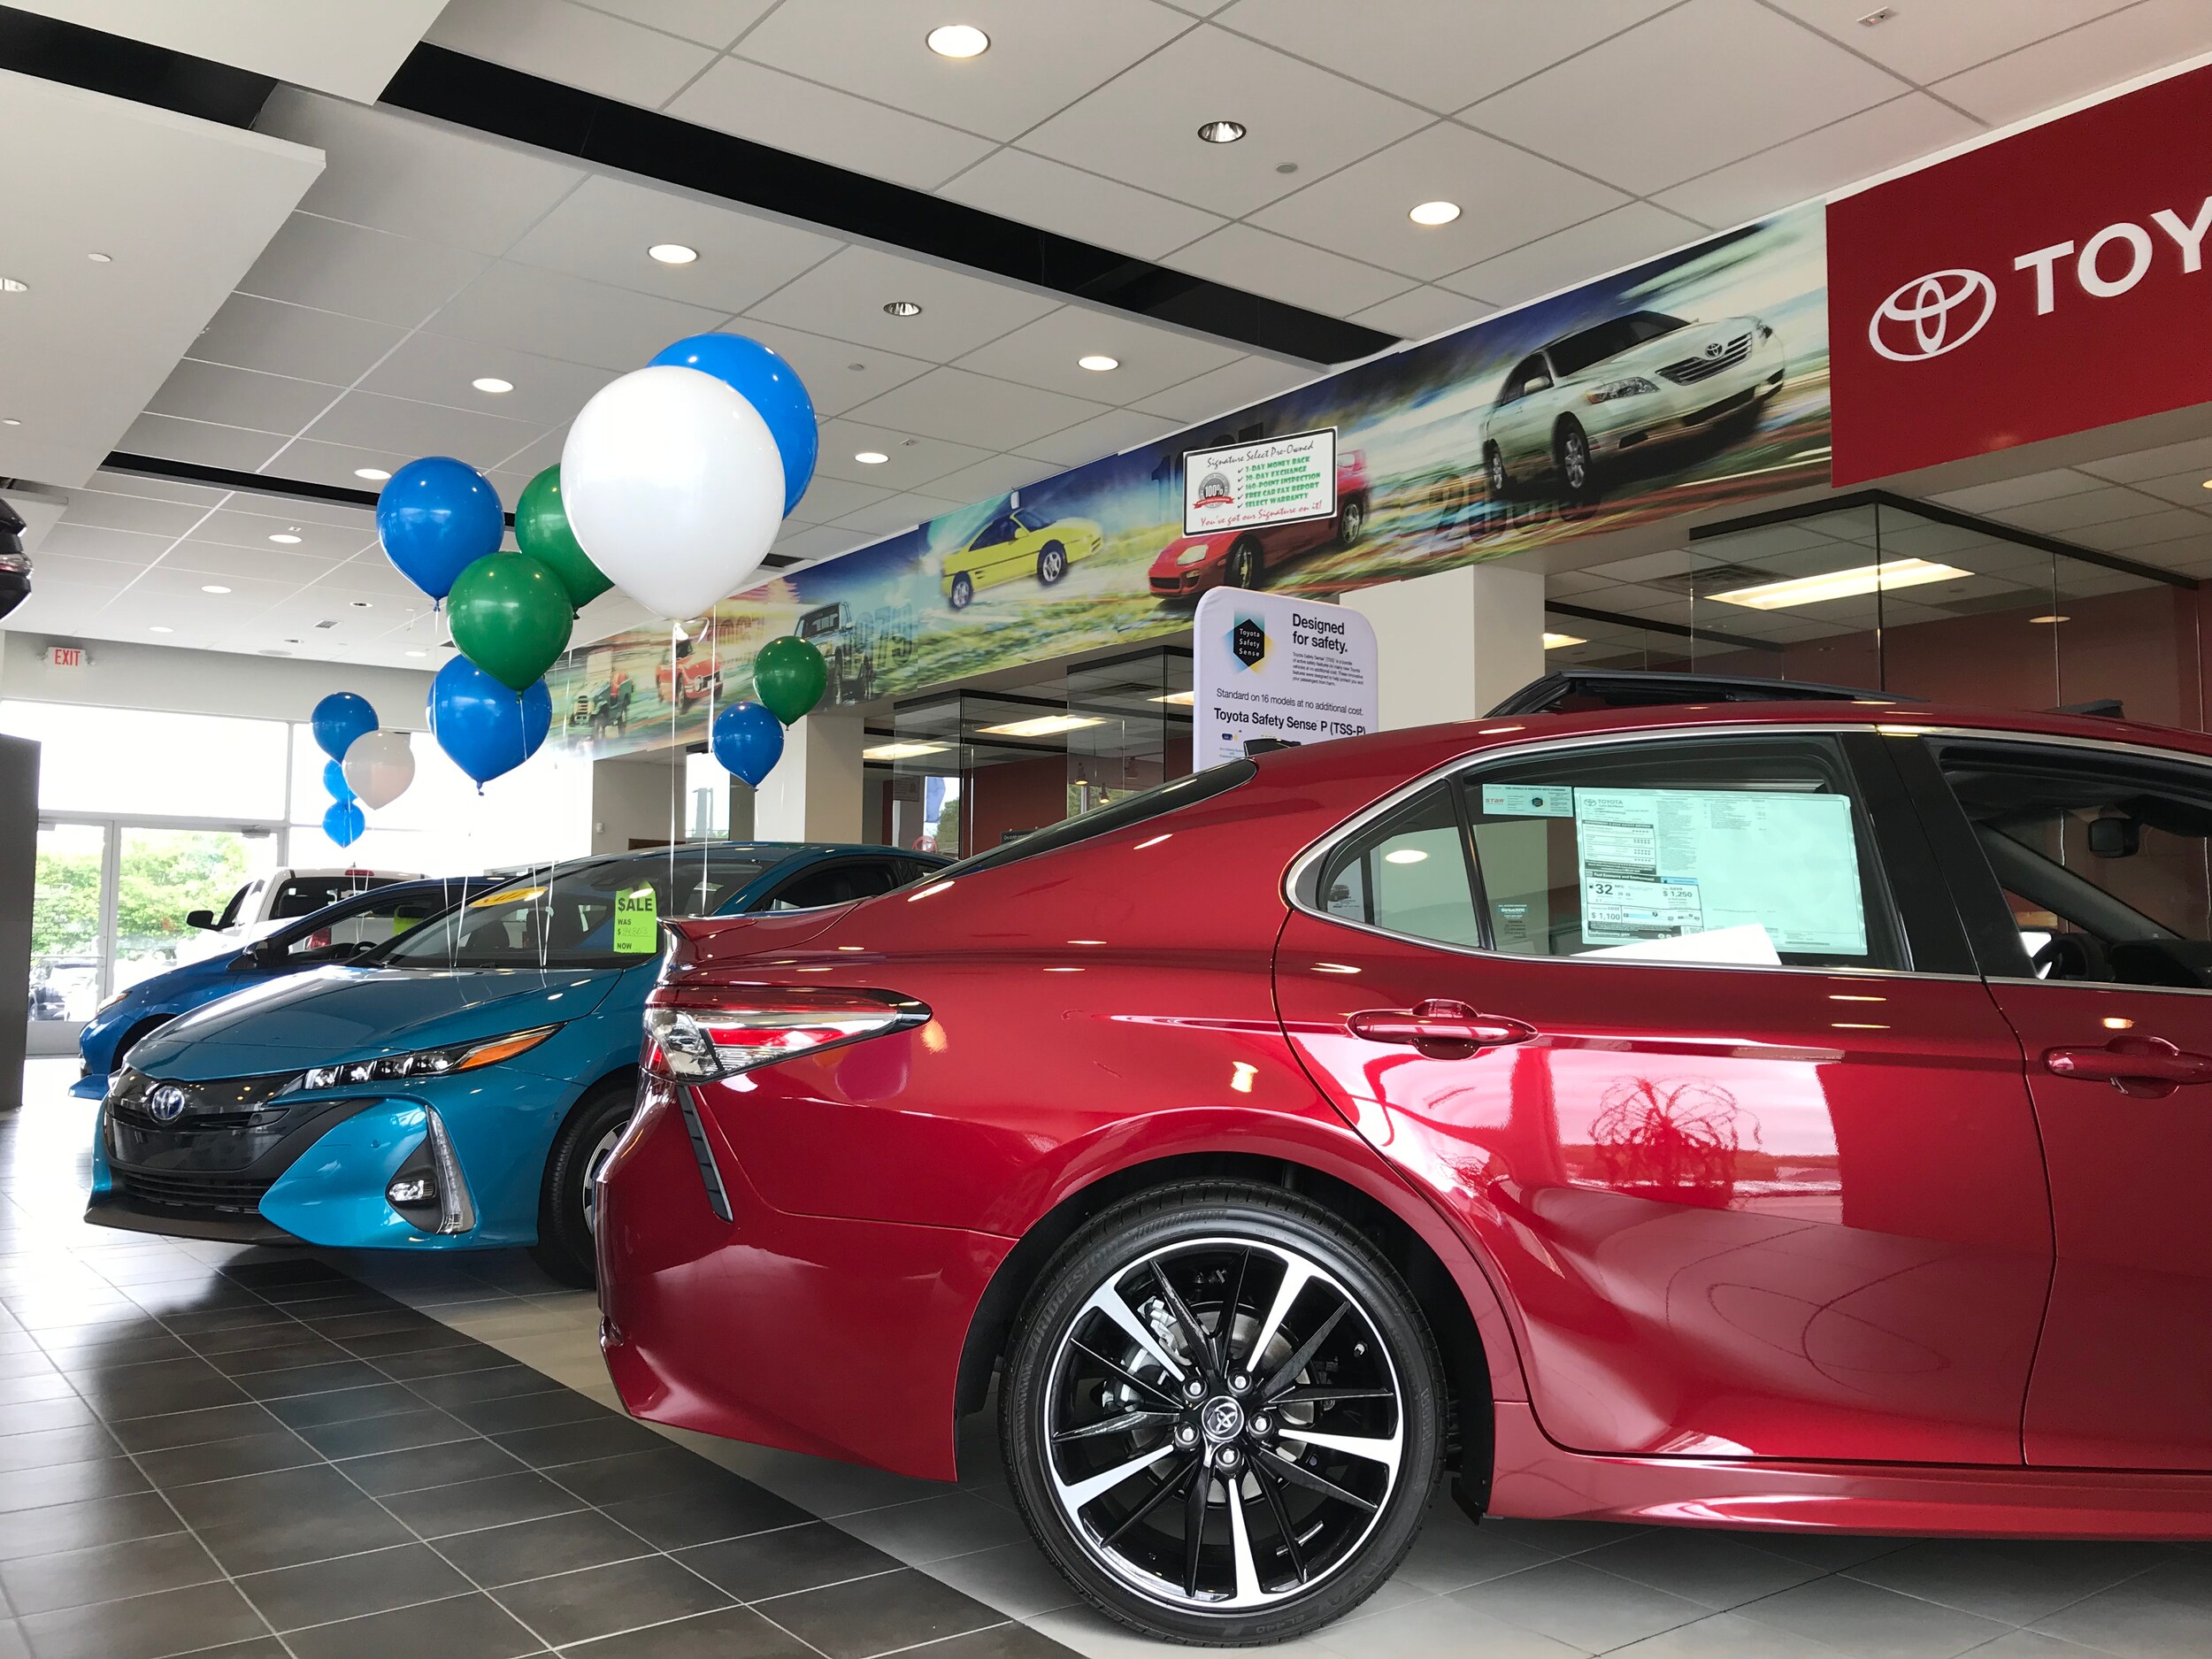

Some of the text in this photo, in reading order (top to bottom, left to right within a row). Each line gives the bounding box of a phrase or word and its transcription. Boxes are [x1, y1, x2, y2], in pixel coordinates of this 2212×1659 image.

[1207, 441, 1314, 470] Signature Select Pre-Owned
[1267, 459, 1291, 468] MONEY
[1292, 456, 1310, 465] BACK
[1271, 465, 1307, 477] EXCHANGE
[1281, 472, 1320, 484] INSPECTION
[1205, 485, 1223, 497] 100%
[1292, 481, 1319, 491] REPORT
[1245, 493, 1309, 508] SELECT WARRANTY
[1227, 513, 1240, 526] got
[1258, 508, 1296, 520] Signature
[1293, 613, 1345, 635] Designed
[1239, 628, 1260, 638] Toyota
[1239, 638, 1260, 649] Safety
[1293, 631, 1348, 654] for safety.
[55, 649, 81, 666] EXIT
[1239, 648, 1260, 657] Sense
[1217, 687, 1248, 701] Standard
[1261, 694, 1269, 703] 16
[1271, 695, 1295, 707] models
[1297, 699, 1303, 708] at
[1315, 702, 1347, 713] additional
[1214, 708, 1248, 724] Toyota
[1252, 711, 1285, 729] Safety
[1286, 716, 1317, 731] Sense
[1320, 720, 1327, 732] P
[1595, 883, 1613, 895] 32
